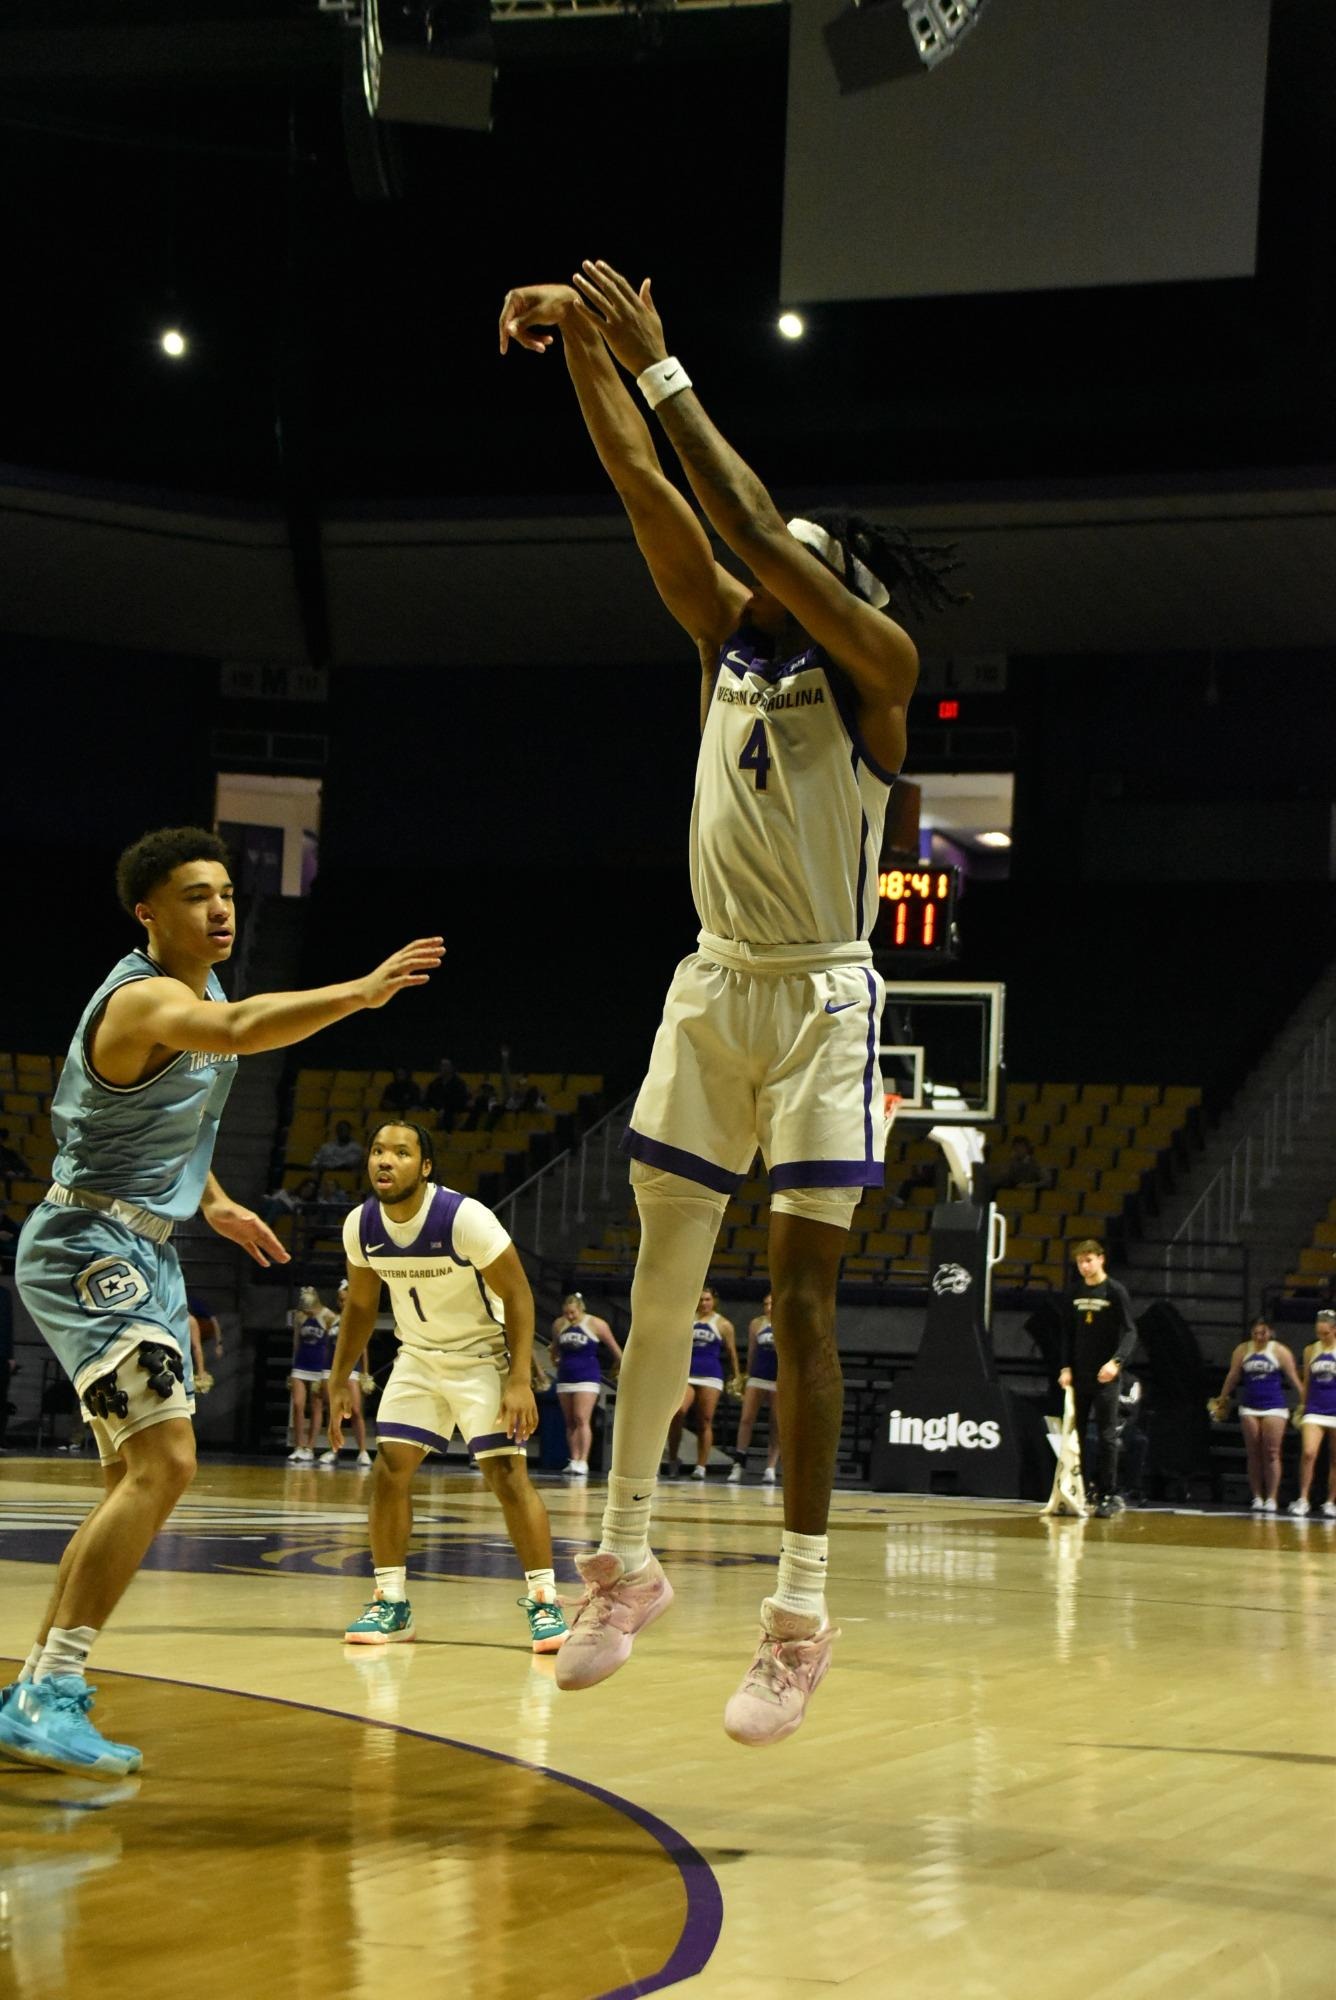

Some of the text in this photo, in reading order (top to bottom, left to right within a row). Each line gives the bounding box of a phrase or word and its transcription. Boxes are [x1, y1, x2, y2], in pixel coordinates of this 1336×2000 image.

[738, 718, 771, 791] 4
[895, 902, 935, 946] 11
[408, 1266, 454, 1279] CAROLINA
[408, 1286, 428, 1323] 1
[889, 1409, 1001, 1452] ingles
